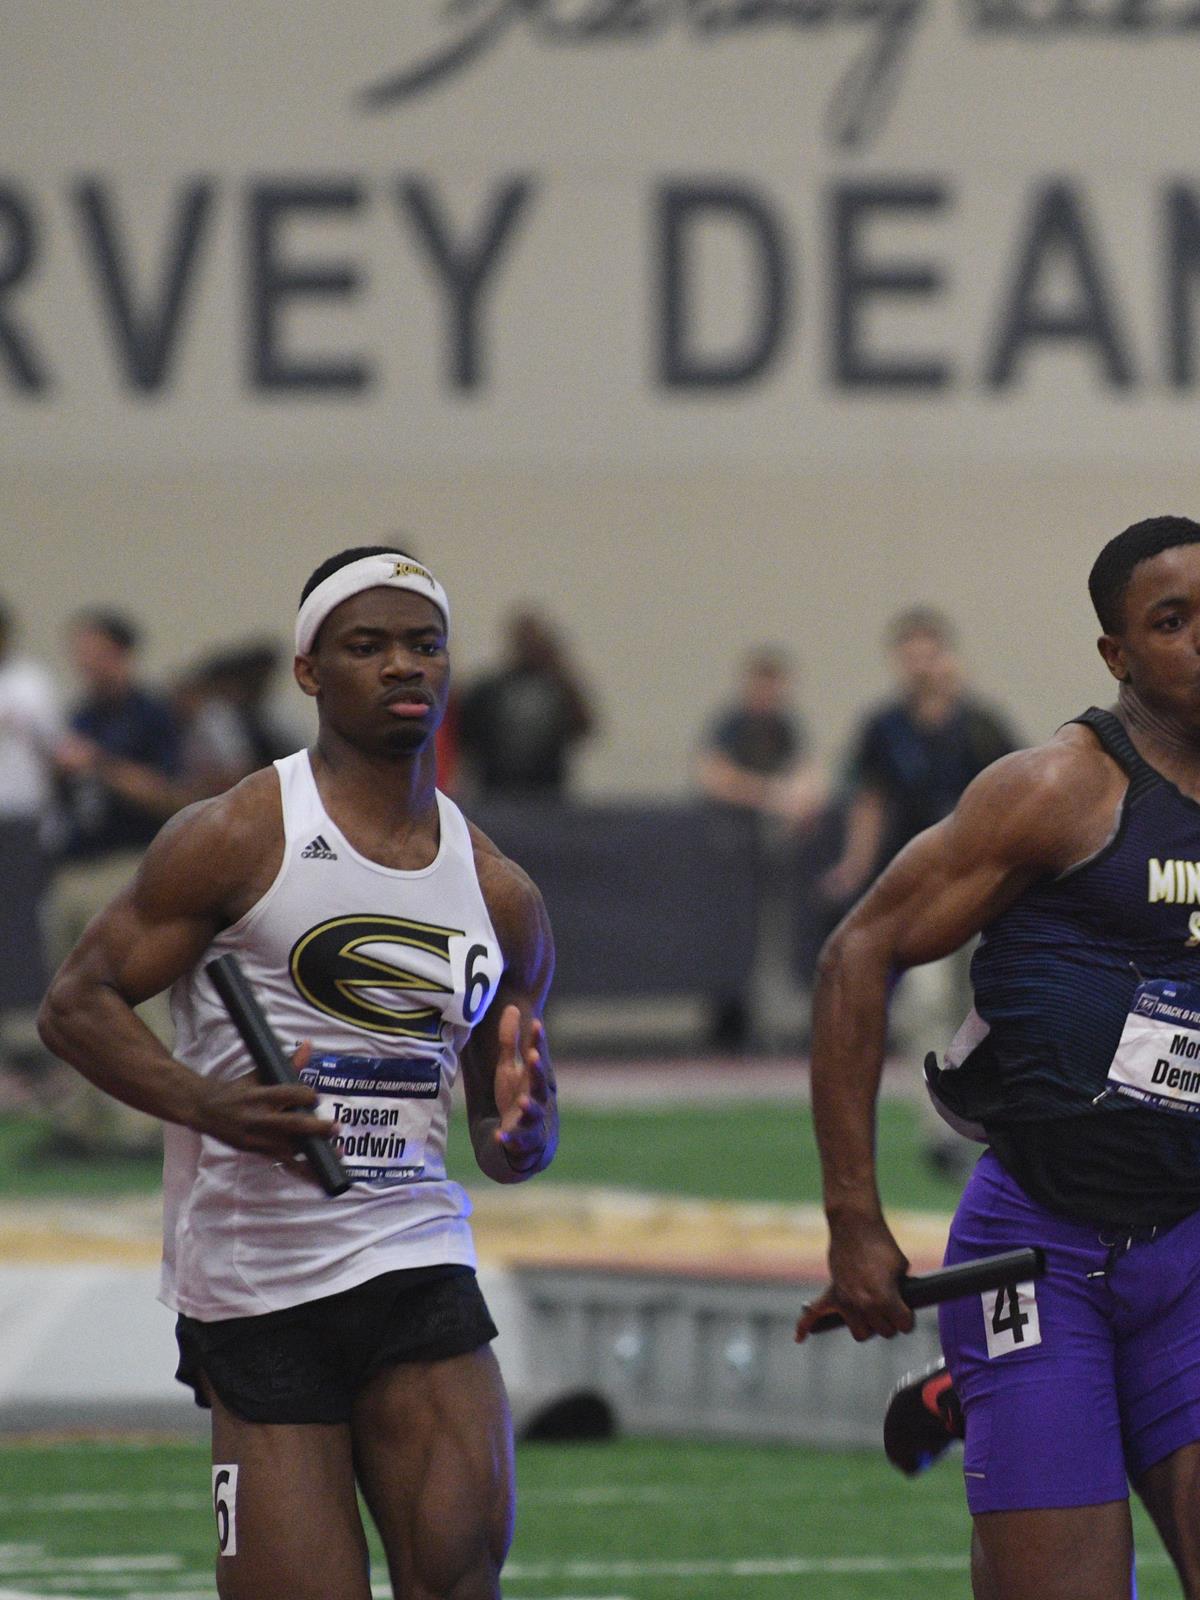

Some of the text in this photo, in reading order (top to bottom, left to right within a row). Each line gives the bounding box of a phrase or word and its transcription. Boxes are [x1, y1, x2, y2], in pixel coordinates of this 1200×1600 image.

[301, 849, 337, 861] adidas
[463, 944, 491, 1023] 6
[1155, 1002, 1184, 1020] TRACK
[318, 1075, 347, 1089] TRACK
[353, 1079, 376, 1090] FIELD
[375, 1080, 437, 1092] CHAMPIONSHIPS
[333, 1103, 400, 1127] Taysean
[331, 1132, 406, 1159] oodwin
[992, 1283, 1029, 1343] 4
[215, 1469, 229, 1553] 6
